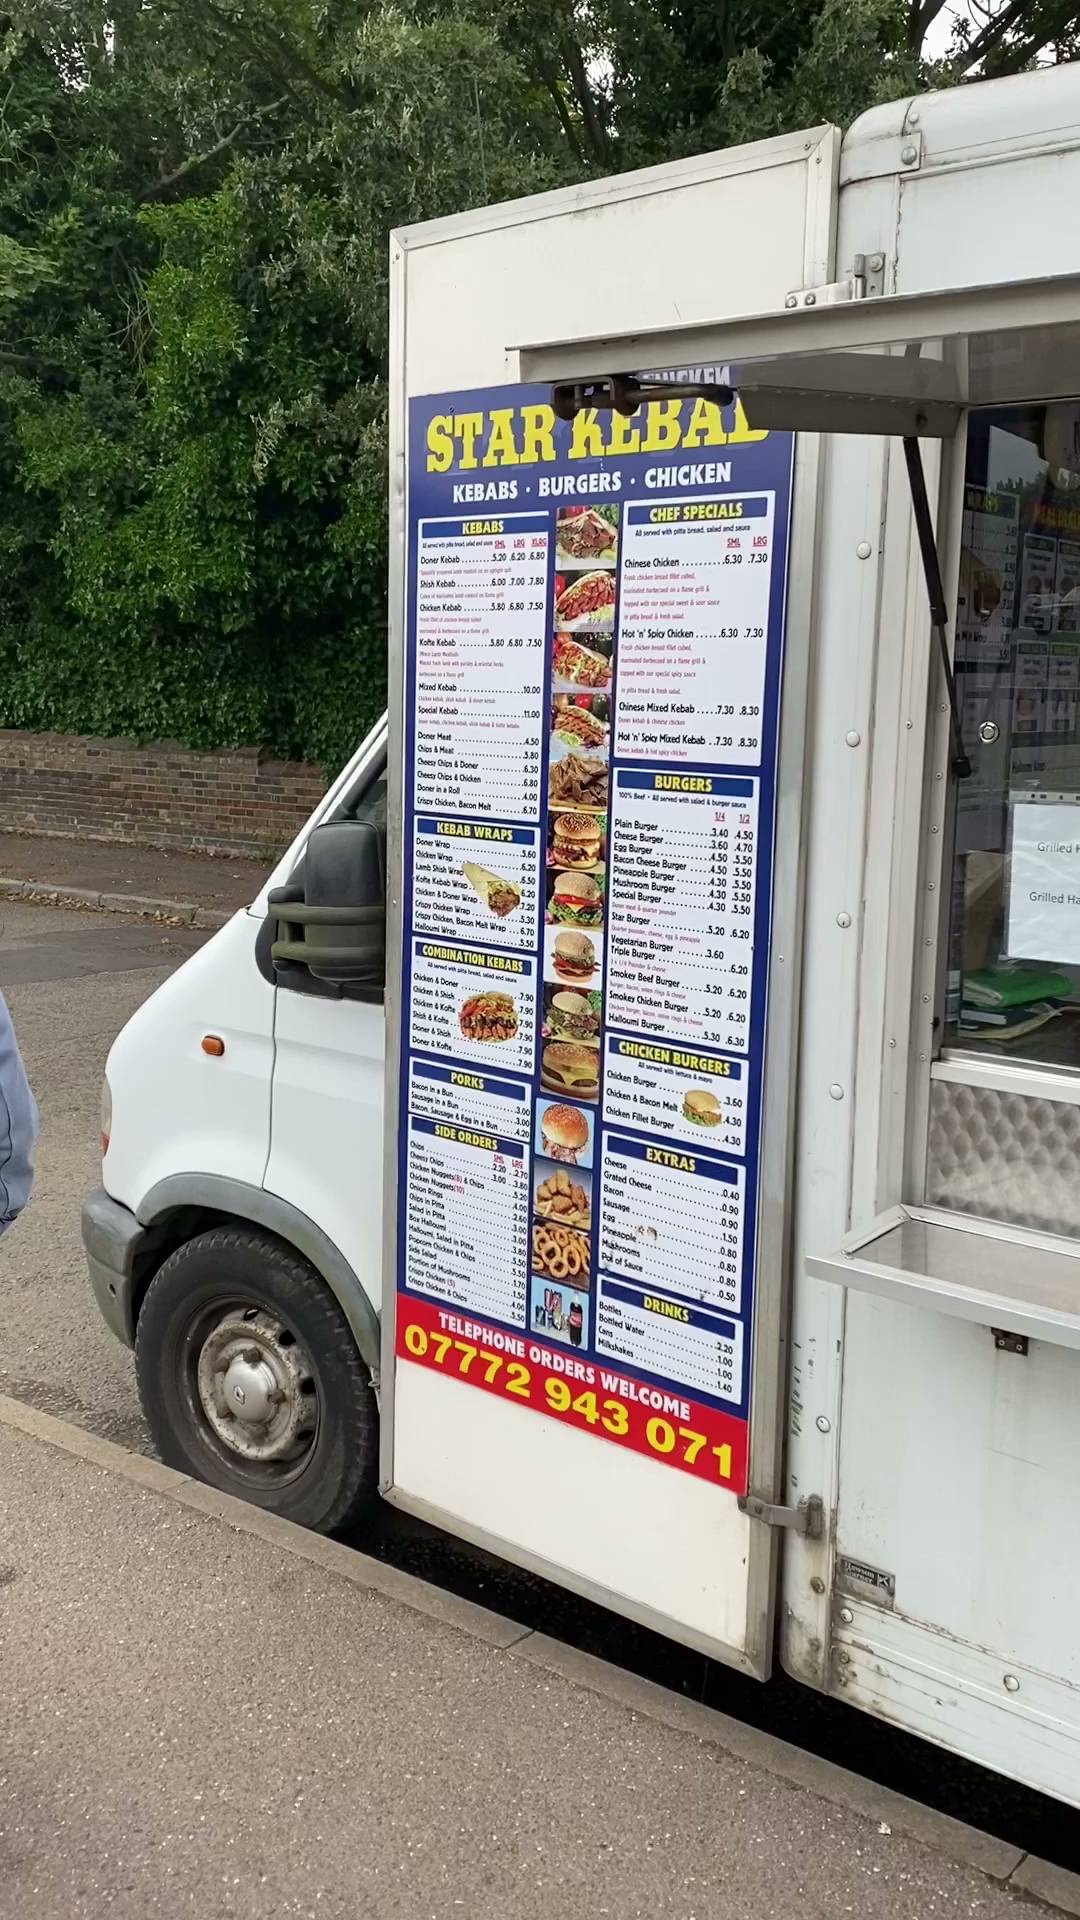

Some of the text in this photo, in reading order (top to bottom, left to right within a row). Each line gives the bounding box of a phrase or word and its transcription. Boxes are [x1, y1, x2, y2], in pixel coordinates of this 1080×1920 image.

[426, 403, 556, 472] STAR
[453, 462, 732, 503] KEBABS BURGERS CHICKEN
[650, 502, 743, 522] CHEF SPECIALS
[462, 520, 504, 534] KEBABS
[494, 540, 506, 548] SML
[514, 539, 525, 548] LRG
[531, 538, 546, 547] XLRG
[727, 536, 767, 548] SML LRG
[421, 556, 438, 564] Doner
[441, 555, 460, 563] Kebab
[625, 559, 650, 568] Chinese
[653, 558, 679, 567] Chicken
[420, 580, 434, 588] Shish
[436, 579, 456, 588] Kebab
[420, 604, 441, 612] Chicken
[622, 629, 635, 638] Hot
[648, 629, 665, 639] Spicy
[667, 629, 693, 638] Chicken
[419, 683, 436, 691] Mixed
[438, 684, 457, 692] Kebab
[418, 707, 437, 715] Special
[439, 707, 458, 715] Kebab
[619, 702, 644, 712] Chinese
[647, 703, 668, 712] Mixed
[671, 704, 695, 714] Kebab
[418, 732, 435, 740] Doner
[437, 733, 451, 741] Meat
[418, 745, 432, 753] Chips
[654, 775, 712, 792] BURGERS
[417, 797, 433, 806] Crispy
[459, 800, 476, 809] Bacon
[478, 803, 491, 811] Melt
[615, 819, 632, 829] Plain
[634, 820, 658, 831] Burger
[715, 812, 750, 824] 1/4 1/2
[436, 822, 513, 841] KEBAB WRAPS
[614, 831, 638, 841] Cheese
[640, 833, 663, 844] Burger
[416, 838, 434, 846] Doner
[435, 840, 450, 849] Wrap
[1038, 842, 1072, 853] Grilled
[416, 850, 436, 860] Chicken
[438, 852, 453, 862] Wrap
[1030, 891, 1064, 903] Grilled
[612, 912, 624, 921] Star
[626, 914, 650, 925] Burger
[415, 922, 440, 932] Halloumi
[441, 926, 456, 936] Wrap
[611, 935, 647, 948] Vegetarian
[650, 940, 673, 952] Burger
[422, 945, 485, 966] COMBINATION
[487, 957, 523, 973] KEBABS
[414, 973, 434, 983] Chicken
[441, 977, 459, 988] Doner
[619, 1042, 730, 1075] CHICKEN BURGERS
[451, 1072, 484, 1089] PORKS
[607, 1070, 631, 1082] Chicken
[633, 1075, 657, 1089] Burger
[411, 1081, 428, 1092] Bacon
[442, 1089, 454, 1097] Bun
[606, 1106, 630, 1119] Chicken
[632, 1112, 648, 1124] Fillet
[650, 1117, 674, 1130] Burger
[435, 1125, 498, 1151] SIDE ORDERS
[604, 1157, 627, 1170] Cheese
[646, 1148, 696, 1171] EXTRAS
[604, 1170, 627, 1184] Grated
[629, 1177, 652, 1191] Cheese
[410, 1182, 426, 1193] Onion
[428, 1188, 443, 1199] Rings
[603, 1197, 630, 1213] Sausage
[599, 1301, 622, 1316] Bottles
[643, 1295, 689, 1322] DRINKS
[599, 1313, 623, 1329] Bottled
[625, 1321, 645, 1336] Water
[598, 1338, 634, 1358] Milkshakes
[439, 1312, 690, 1422] TELEPHONE ORDERS WELCOME
[404, 1324, 732, 1480] 07772 943 071
